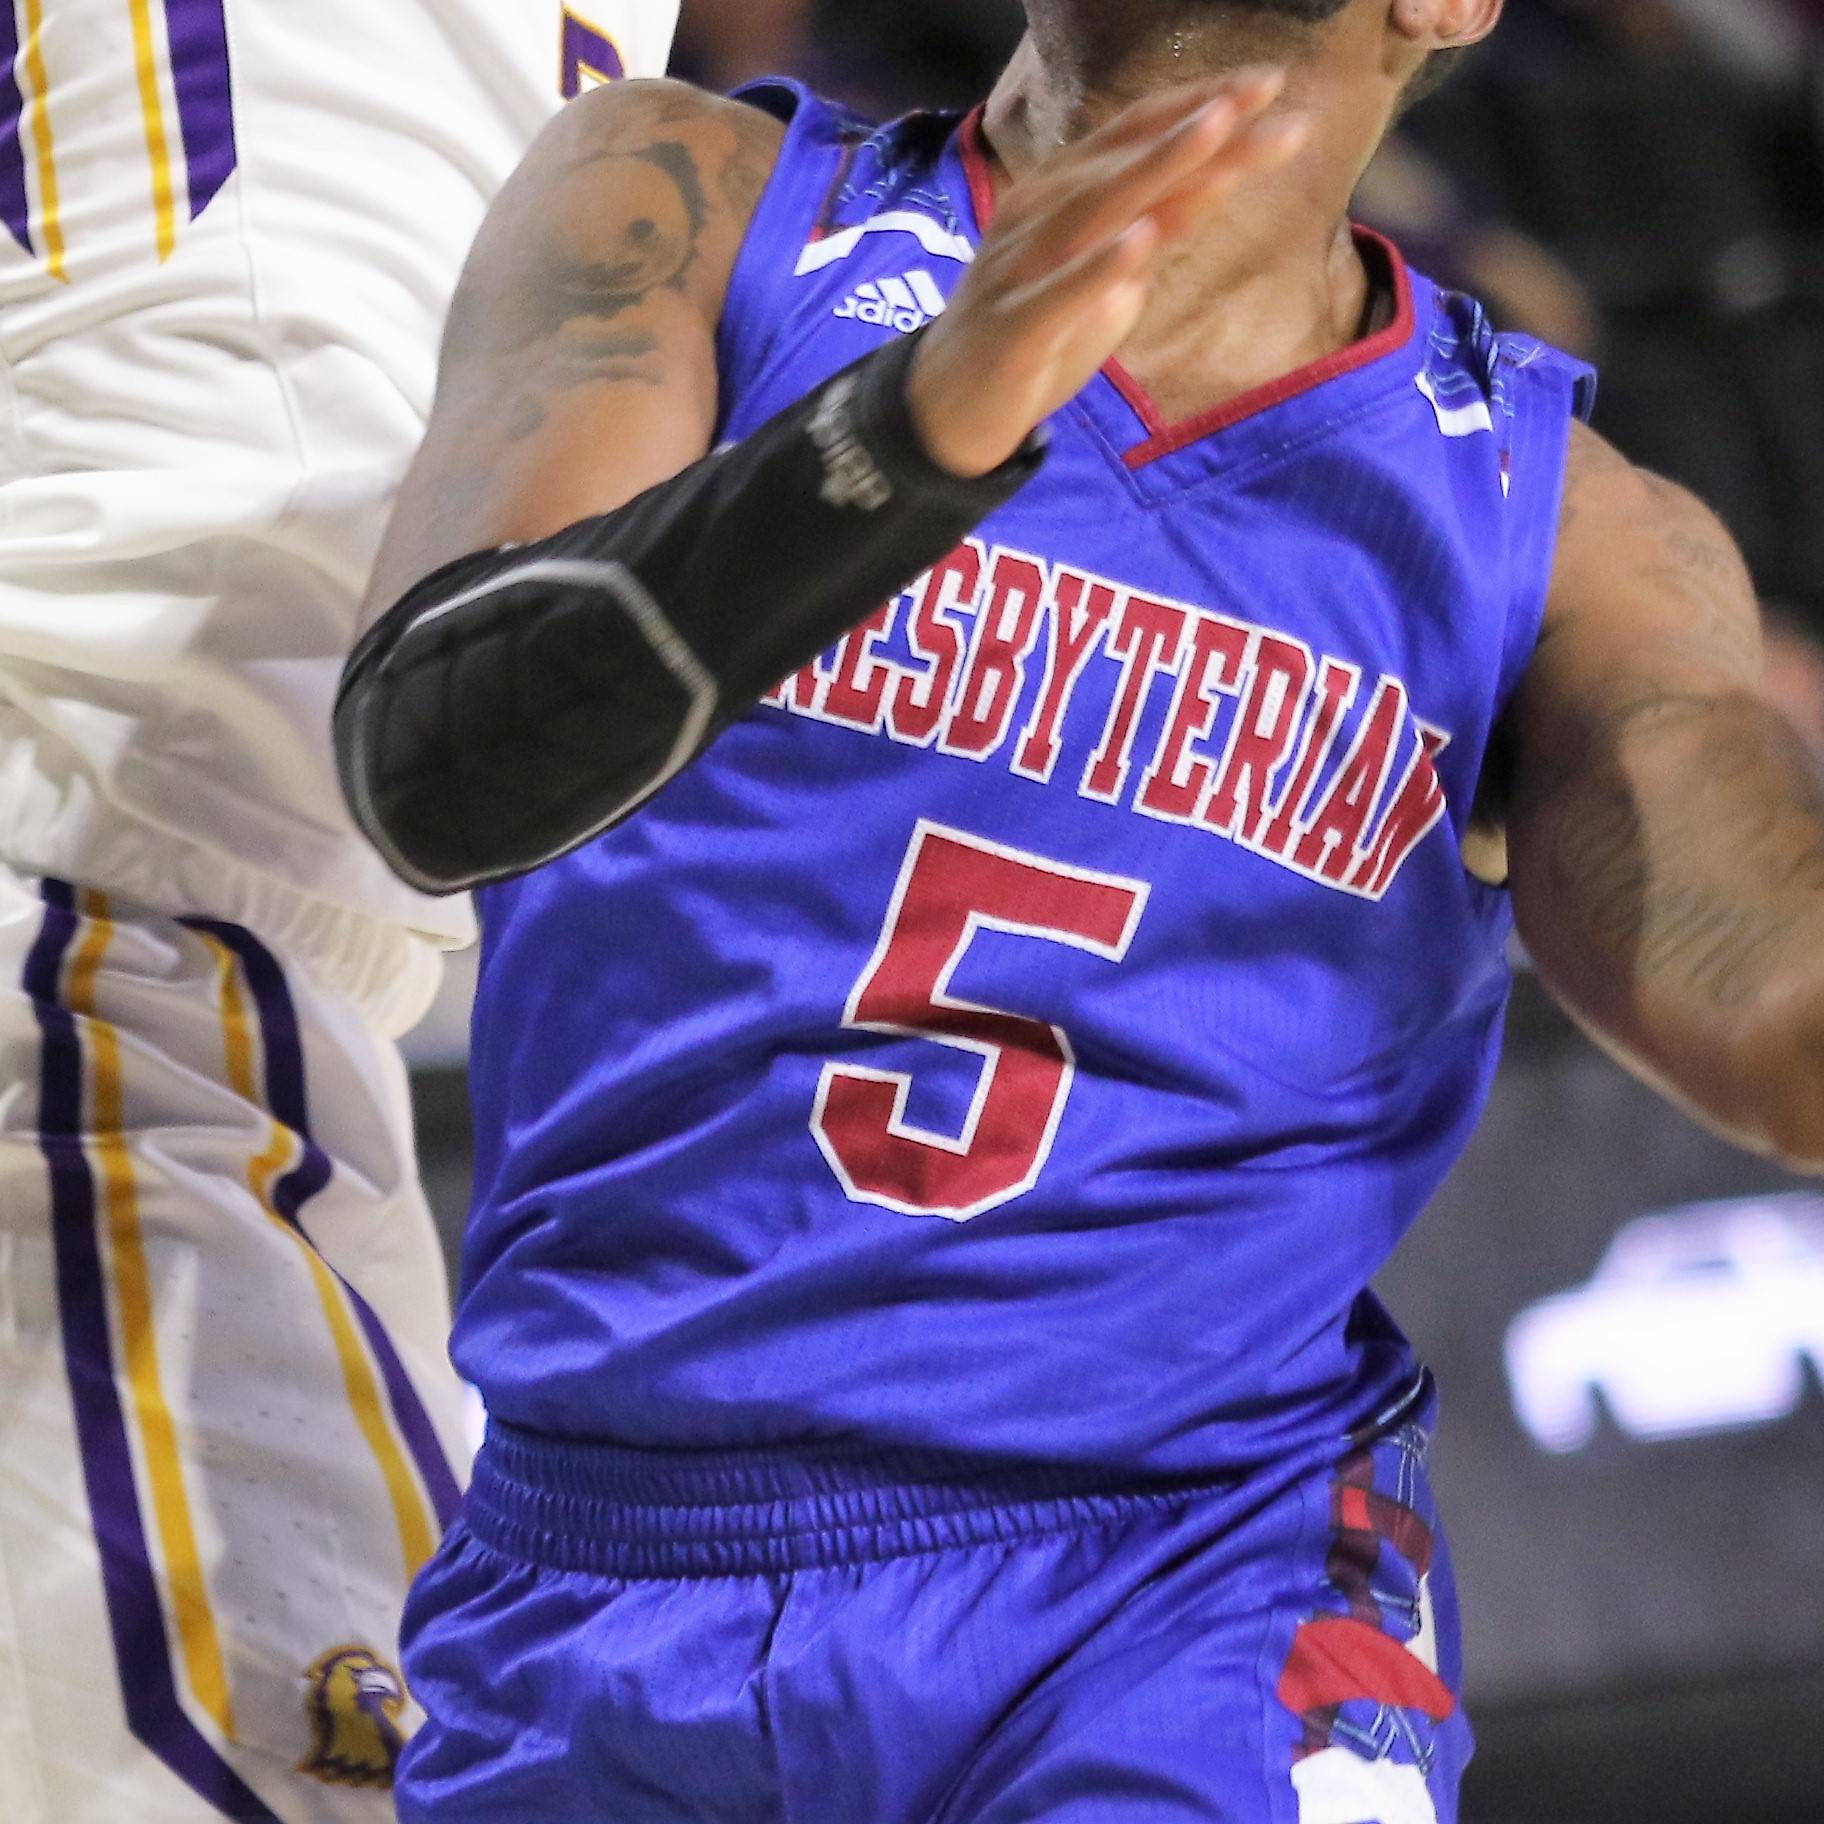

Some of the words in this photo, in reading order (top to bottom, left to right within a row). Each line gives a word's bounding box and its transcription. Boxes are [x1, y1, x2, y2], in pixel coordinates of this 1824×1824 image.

[831, 294, 931, 335] adid
[759, 536, 1452, 902] ESBYTERIAN
[809, 817, 1152, 1223] 5
